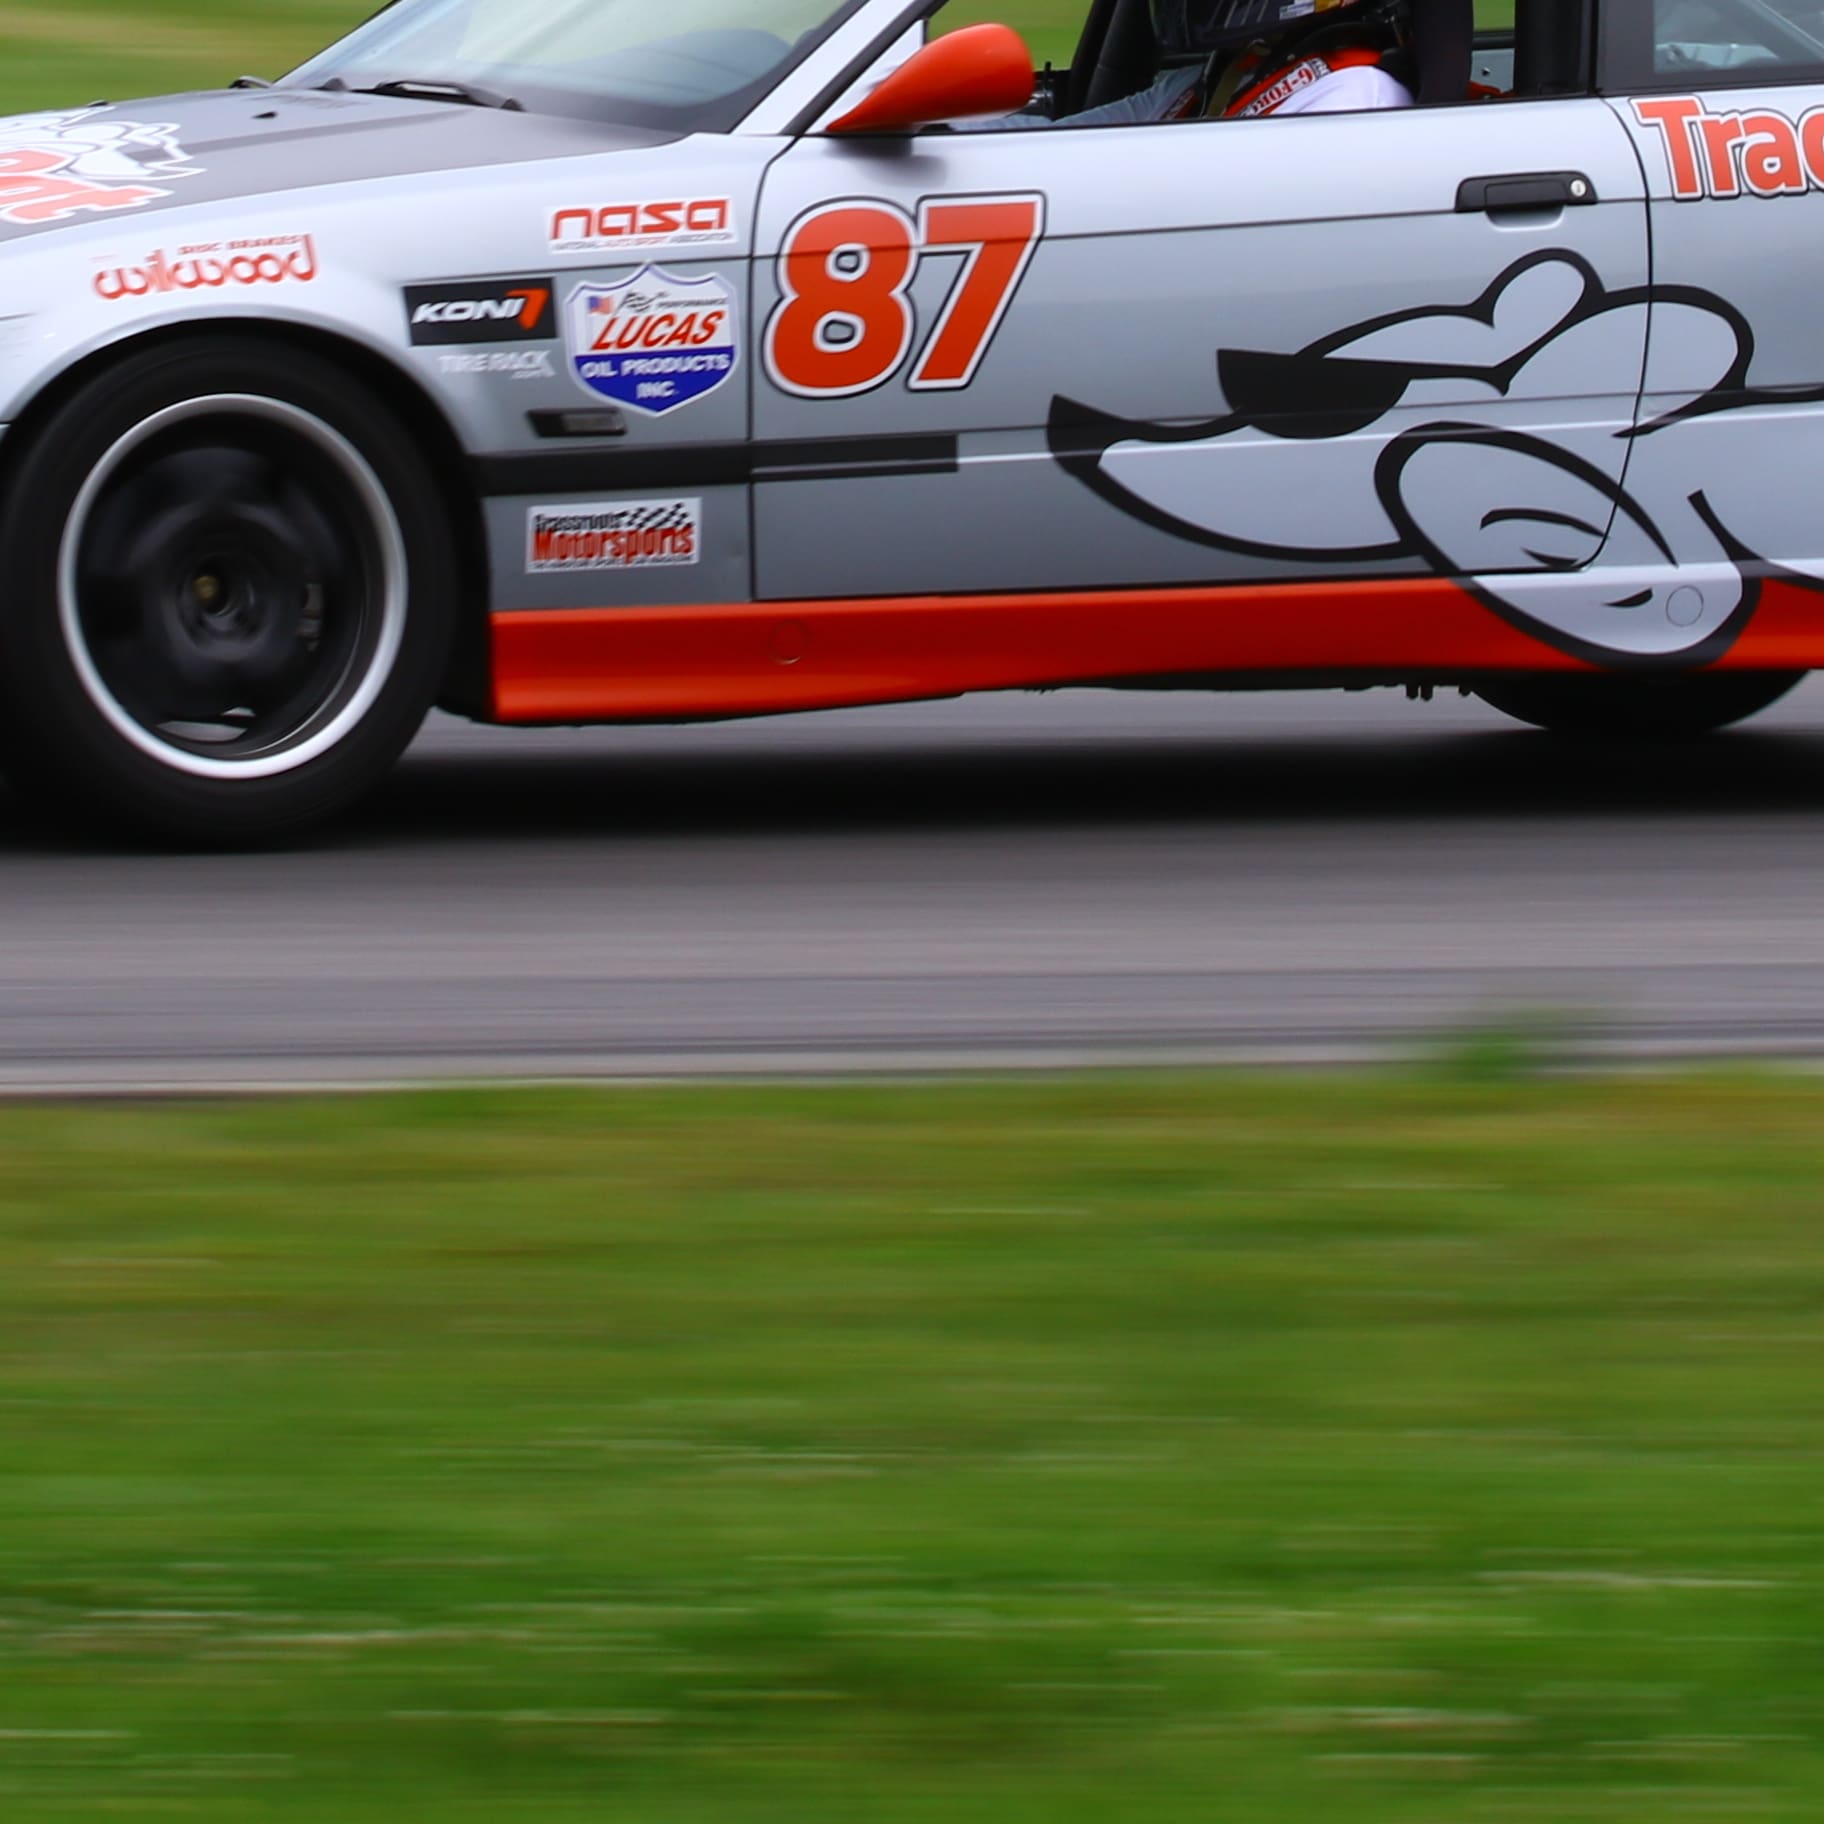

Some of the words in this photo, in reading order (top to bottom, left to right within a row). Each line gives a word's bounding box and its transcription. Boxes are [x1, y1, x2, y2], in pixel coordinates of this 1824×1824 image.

[93, 233, 315, 300] wilwood
[411, 297, 526, 324] KONI
[761, 190, 1046, 400] 87
[590, 309, 726, 351] LUCAS
[580, 360, 618, 378] OIL
[621, 353, 731, 377] PRODUCTS
[533, 522, 696, 565] Motorsports
